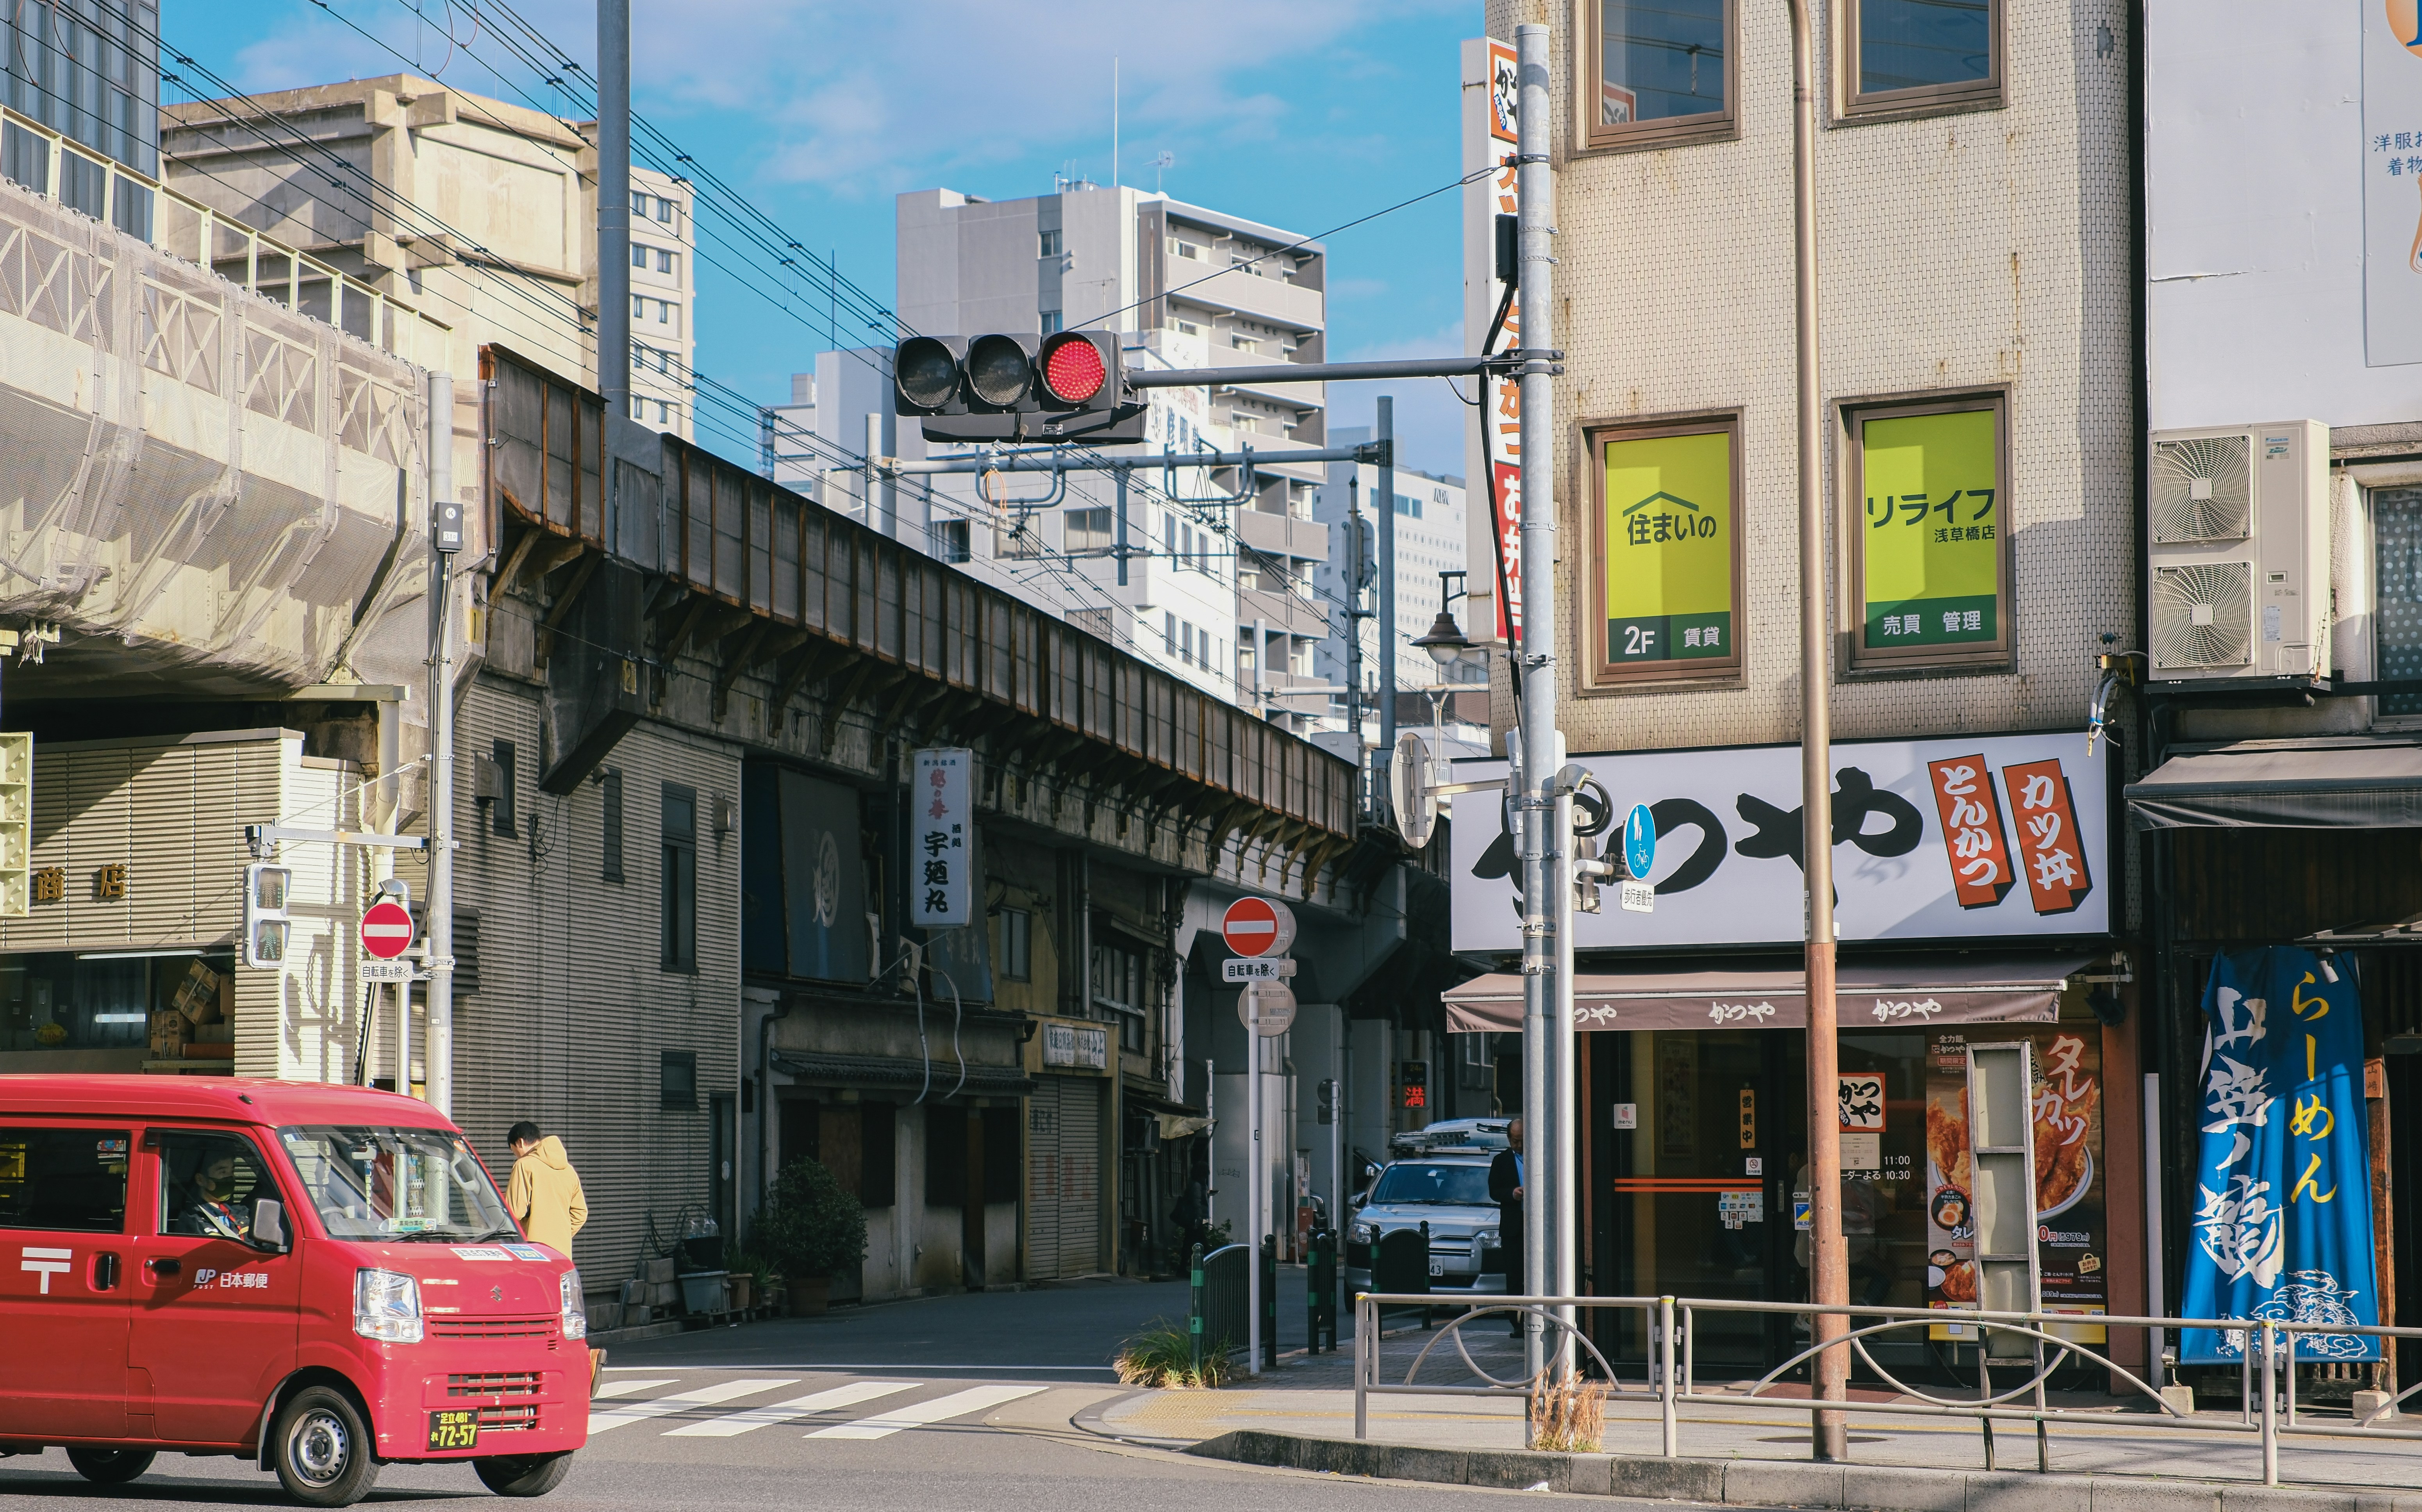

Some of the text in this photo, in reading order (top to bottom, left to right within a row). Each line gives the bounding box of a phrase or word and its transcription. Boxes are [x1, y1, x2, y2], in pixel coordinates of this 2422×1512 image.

[2387, 155, 2422, 176] 着物
[1434, 488, 1450, 505] APA
[1867, 489, 1995, 529] リライフ
[1628, 512, 1717, 546] 住まいの
[1935, 524, 1995, 544] 浅草橋店
[1883, 610, 1981, 635] 売買 管理
[1624, 626, 1655, 654] 2F
[1684, 626, 1720, 648] 賃貸
[952, 824, 962, 848] 酒処
[1940, 765, 1998, 886] とんかつ
[2020, 774, 2078, 891] カツ丼
[1624, 888, 1652, 906] 歩行者優先
[362, 965, 409, 978] 自転車を除く
[1228, 963, 1274, 977] 自転車を除く
[1574, 1004, 1617, 1026] つや
[1708, 1002, 1776, 1024] かつや
[1872, 998, 1942, 1022] かつや
[1940, 1045, 1966, 1054] かつや
[1406, 1087, 1425, 1107] 満
[2290, 971, 2337, 1203] らーめん
[1742, 1095, 1753, 1143] 営業中
[1885, 1156, 1910, 1165] 11:00
[1886, 1171, 1910, 1180] 10:30
[195, 1269, 216, 1284] JP
[220, 1272, 268, 1288] 日本郵便
[1430, 1265, 1441, 1275] 43
[440, 1412, 468, 1424] 足立 481
[430, 1432, 439, 1442] れ
[439, 1424, 477, 1446] 72-57
